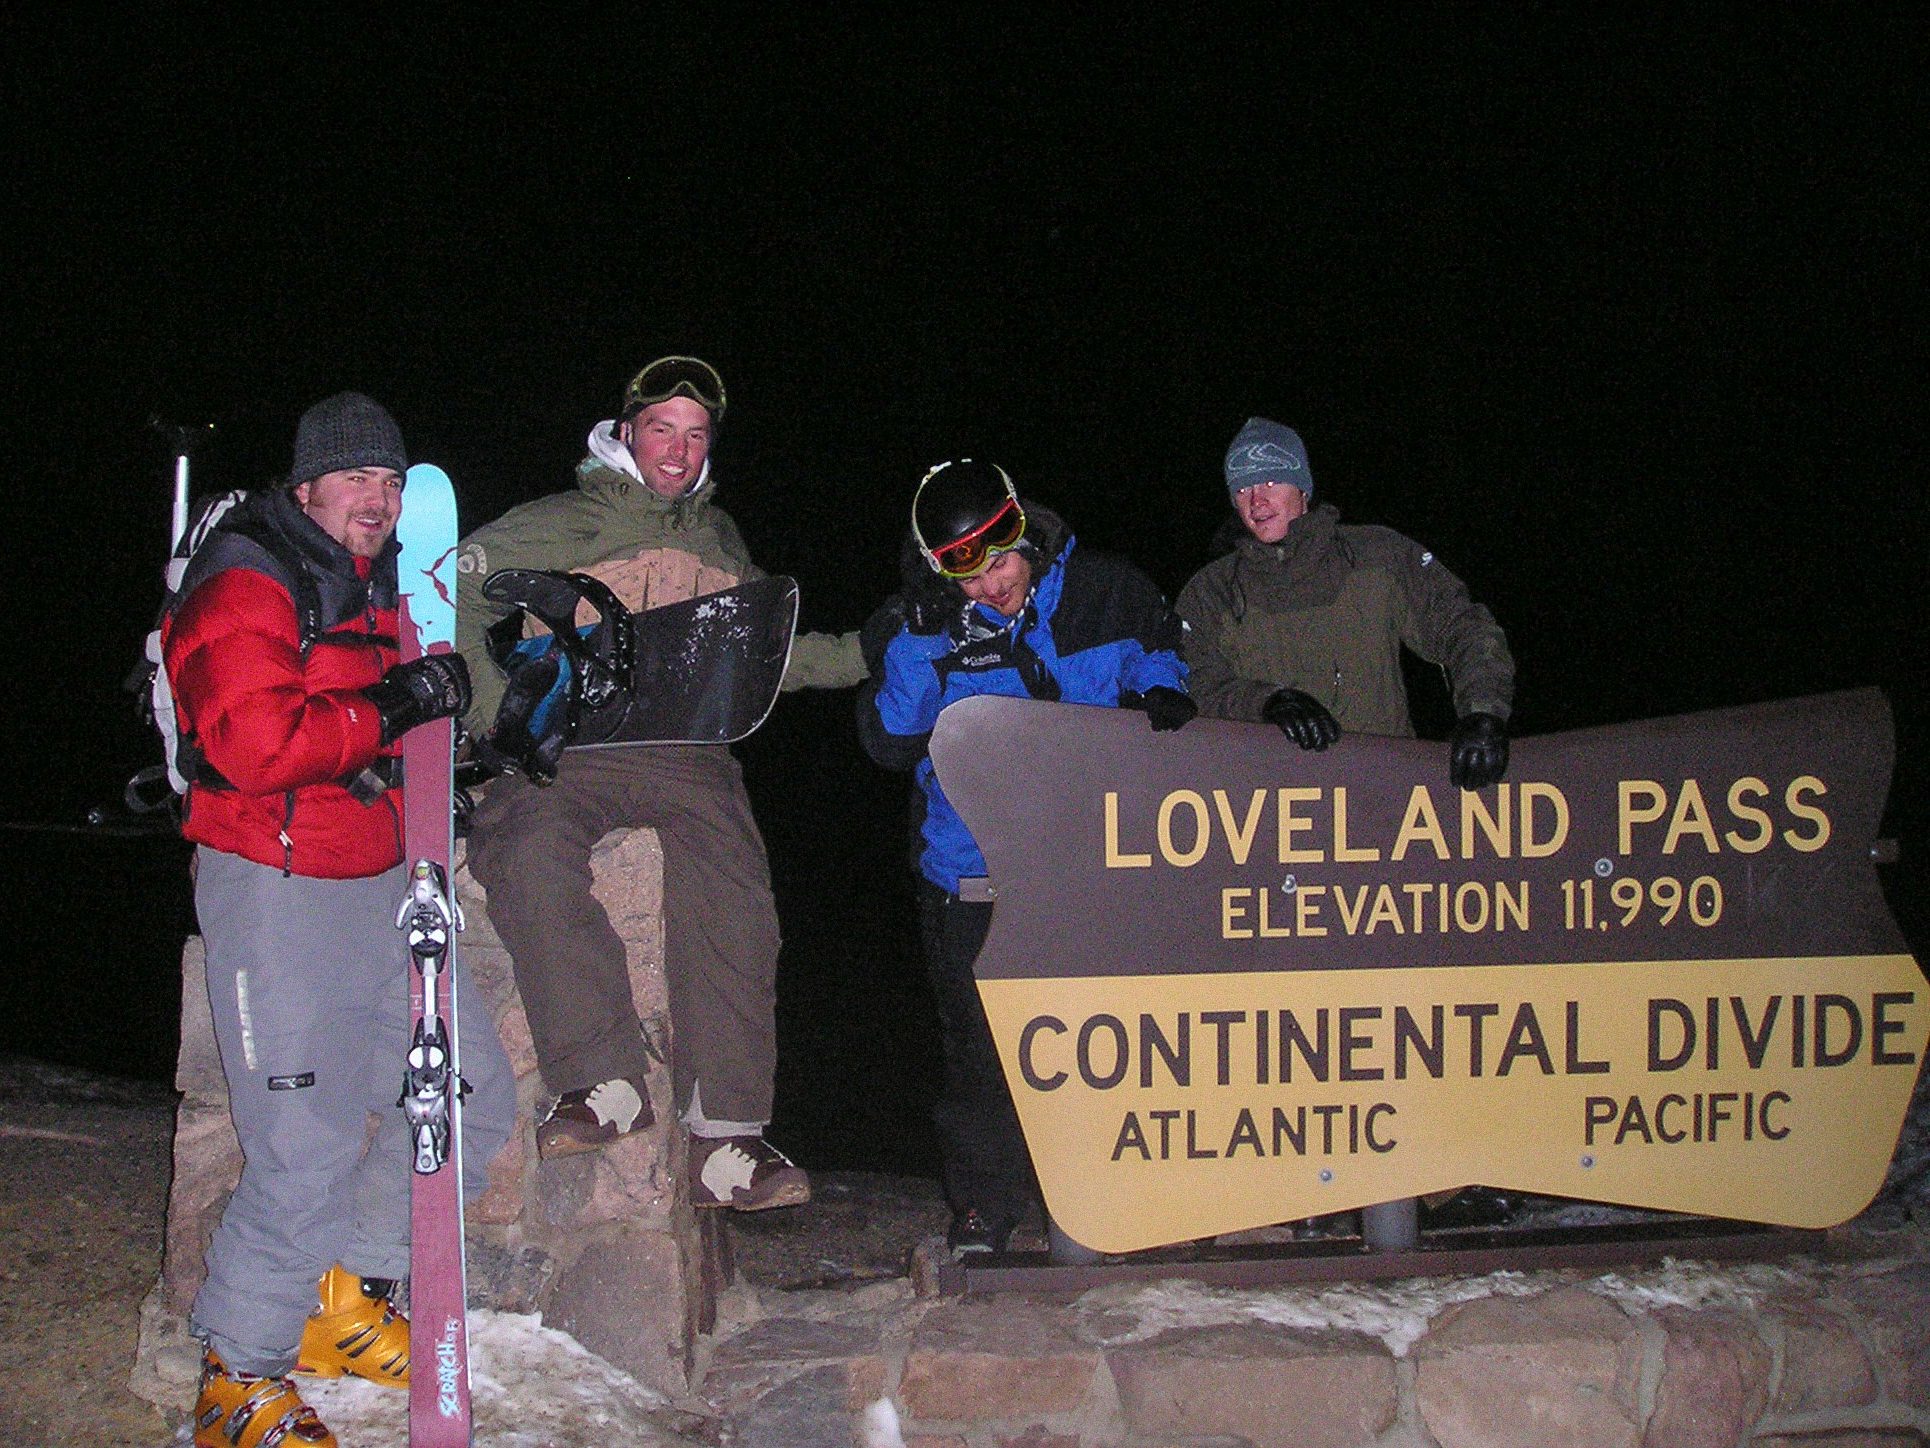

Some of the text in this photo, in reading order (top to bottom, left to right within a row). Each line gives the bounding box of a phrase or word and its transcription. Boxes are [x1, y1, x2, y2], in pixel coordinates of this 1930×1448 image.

[1105, 775, 1831, 868] LOVELAND PASS
[1222, 880, 1530, 938] ELEVATION
[1018, 991, 1916, 1092] CONTINENTAL DIVIDE
[1111, 1091, 1792, 1161] ATLANTIC PACIFIC
